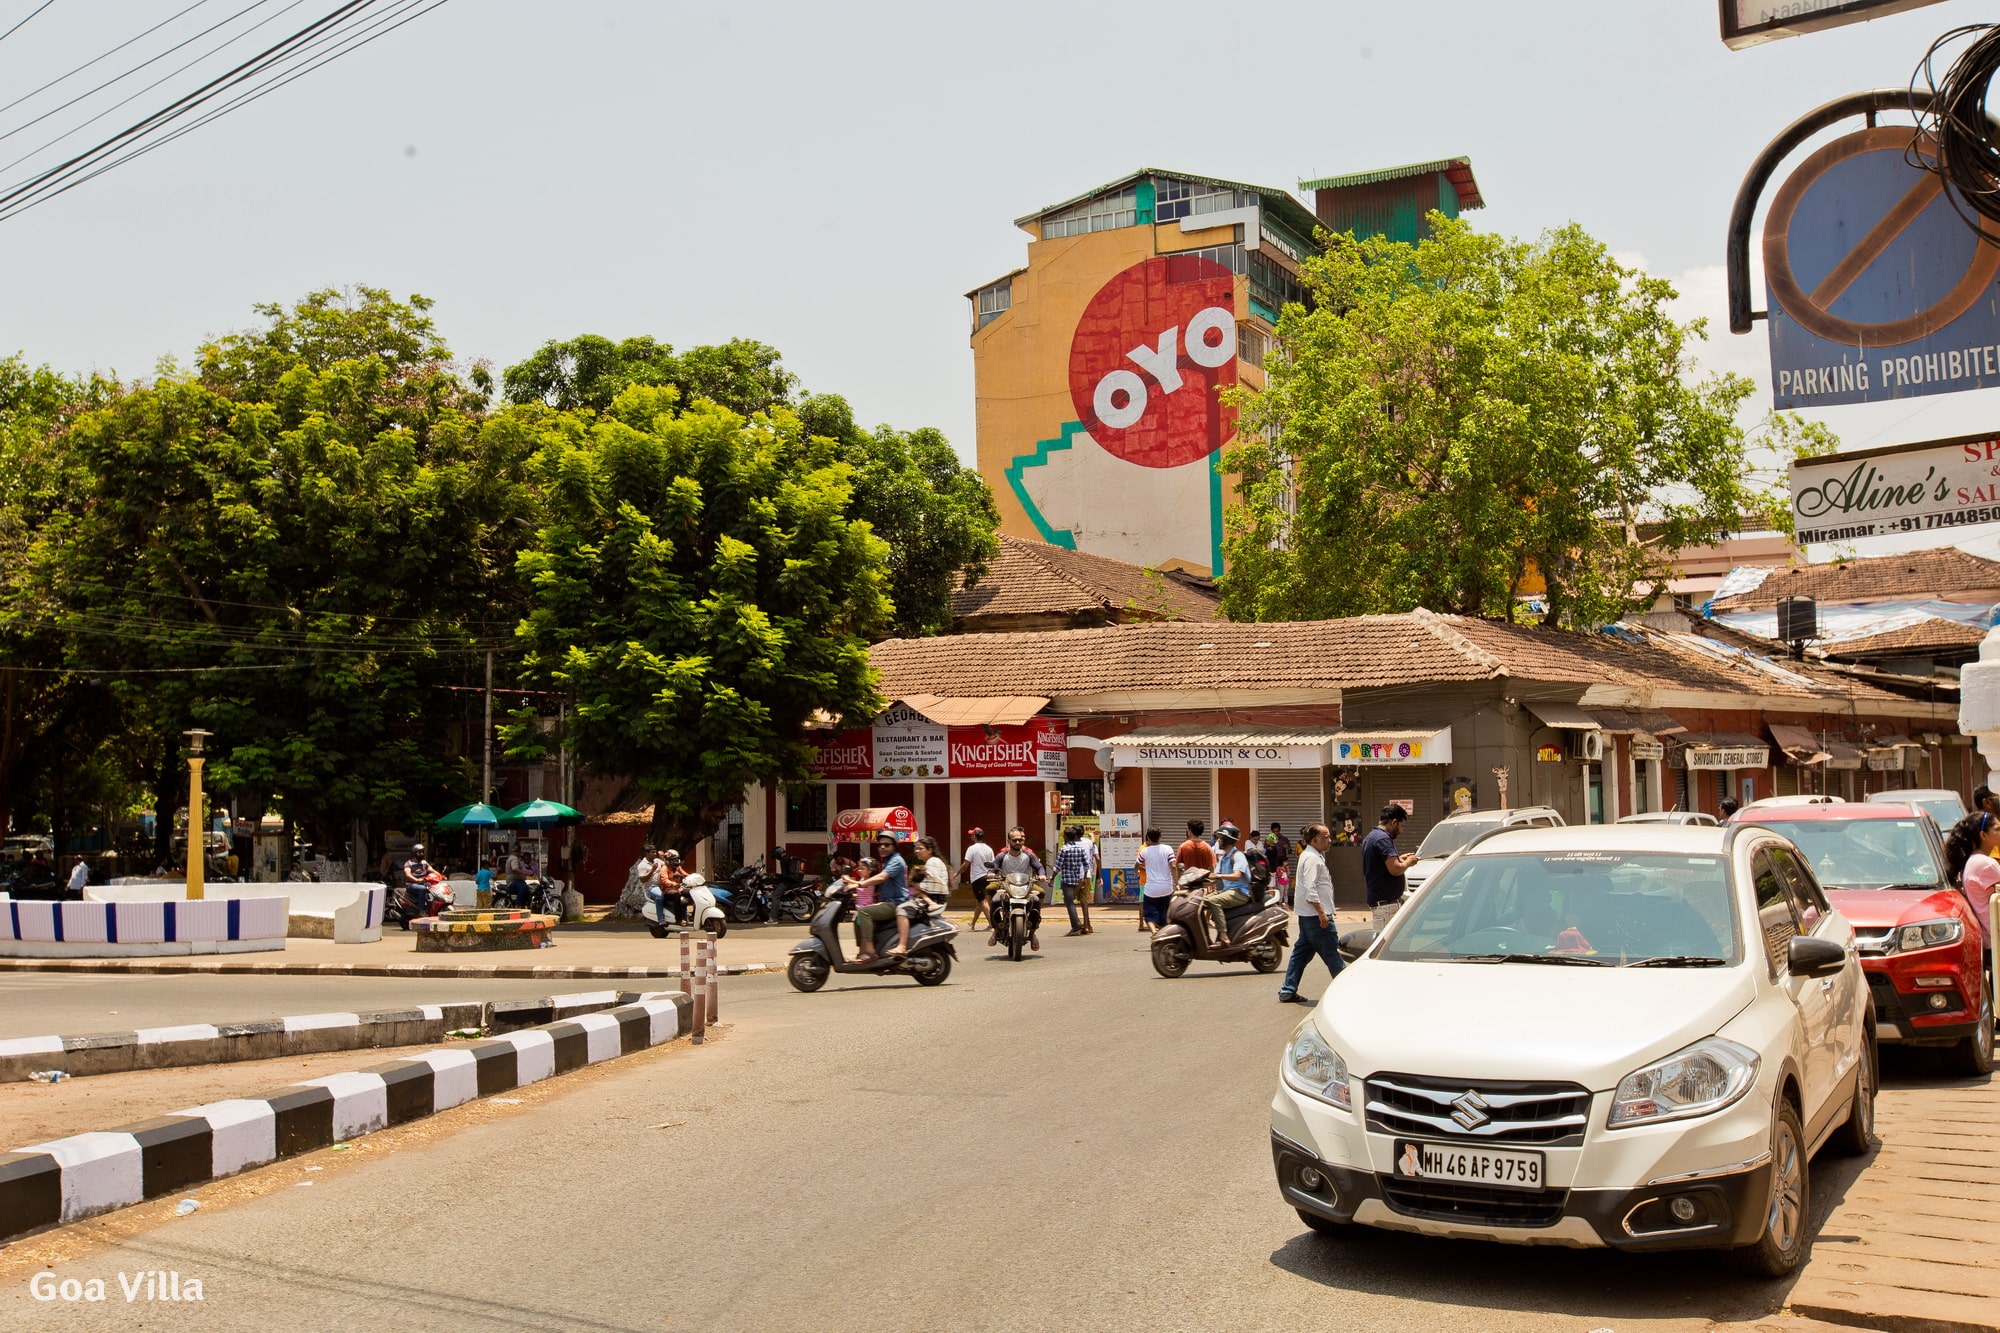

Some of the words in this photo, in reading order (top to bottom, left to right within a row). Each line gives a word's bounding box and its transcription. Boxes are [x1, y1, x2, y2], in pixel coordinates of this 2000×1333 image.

[1093, 307, 1236, 429] OYO
[1779, 362, 1869, 397] PARKING
[1796, 461, 1950, 518] Aline's
[1798, 522, 1876, 544] Miramar
[1037, 730, 1067, 747] KINGFISHER
[950, 740, 1037, 767] KINGFISHER
[1043, 751, 1061, 761] GEORGE
[1139, 748, 1232, 759] SHAMSUDDIN
[1238, 749, 1250, 759] &
[1255, 749, 1282, 759] CO.
[1339, 743, 1394, 758] PARTY
[1398, 742, 1422, 758] ON
[1539, 748, 1555, 761] PARTY
[1693, 753, 1722, 766] SHIVDATTA
[1723, 752, 1744, 765] GENERAL
[1745, 752, 1764, 764] STORES
